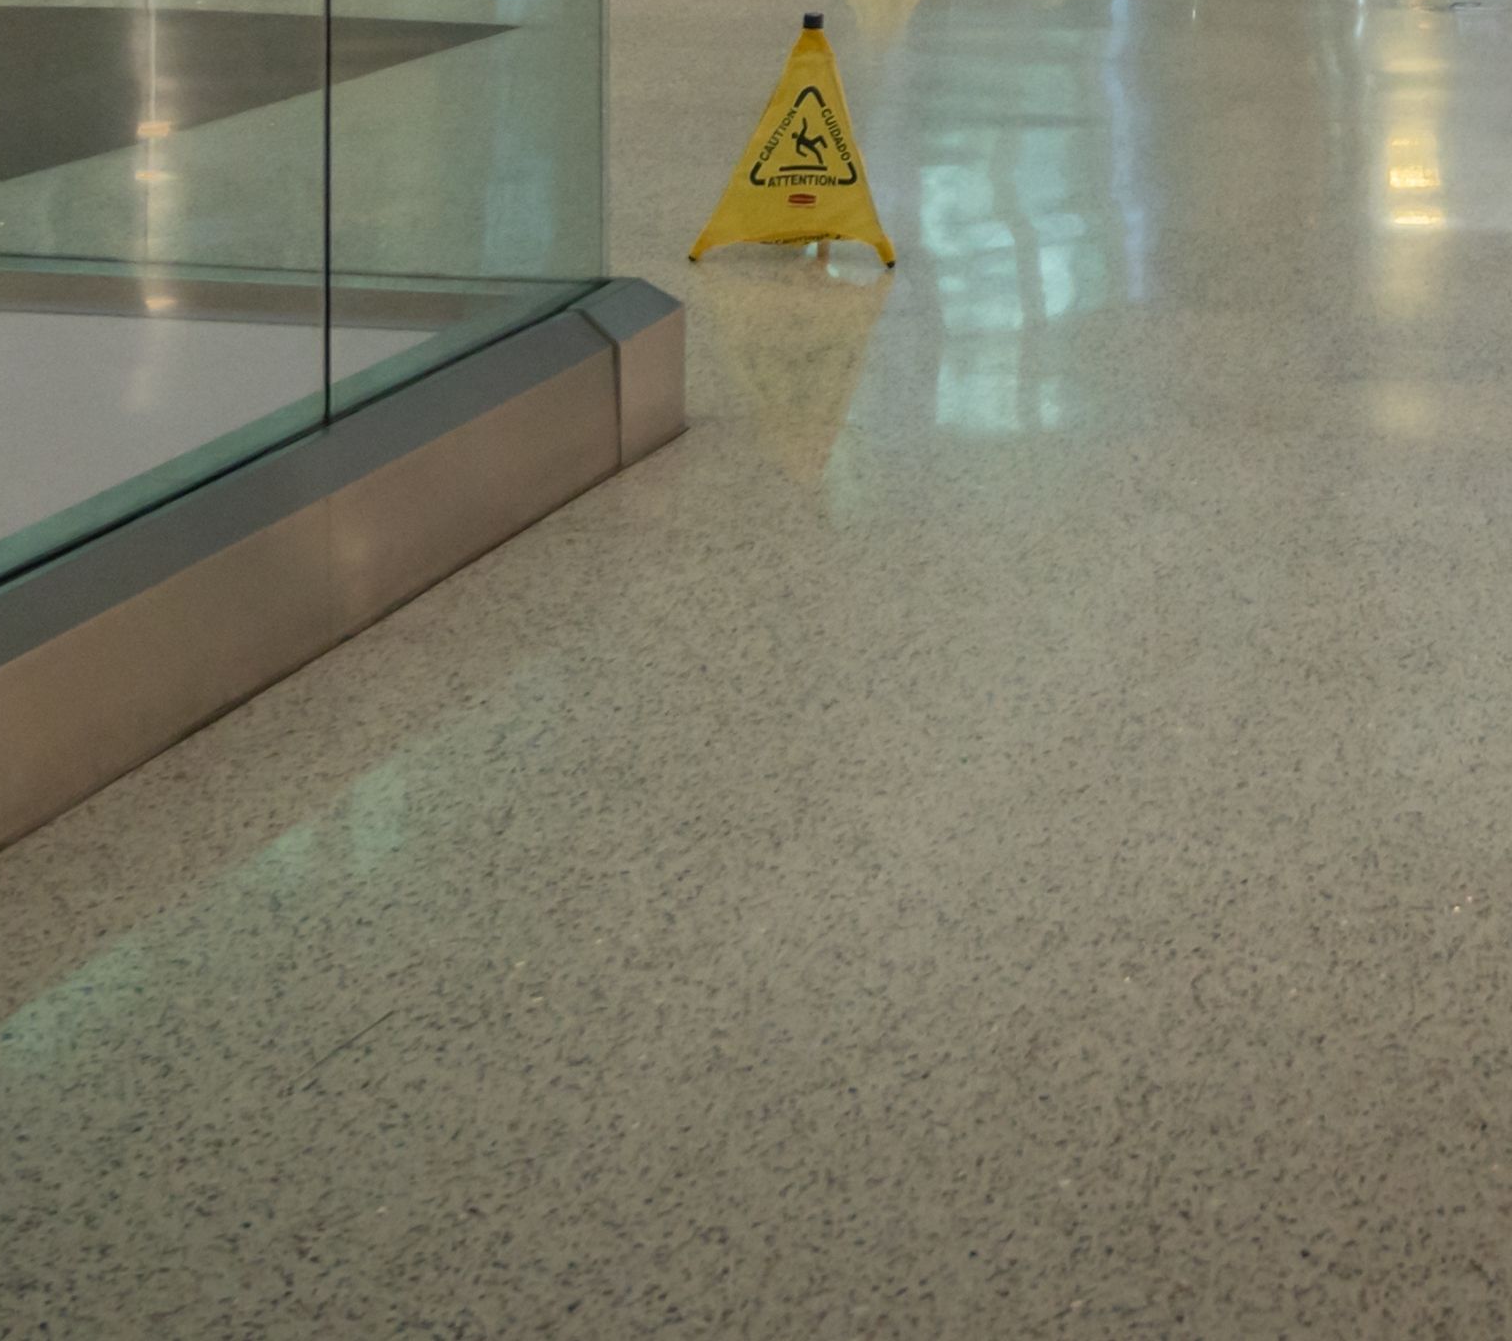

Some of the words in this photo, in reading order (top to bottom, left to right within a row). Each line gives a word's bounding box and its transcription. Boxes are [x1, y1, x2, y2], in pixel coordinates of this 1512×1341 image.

[759, 108, 797, 163] CAUTION
[821, 107, 852, 162] CUIDADO
[767, 173, 838, 189] ATTENTION
